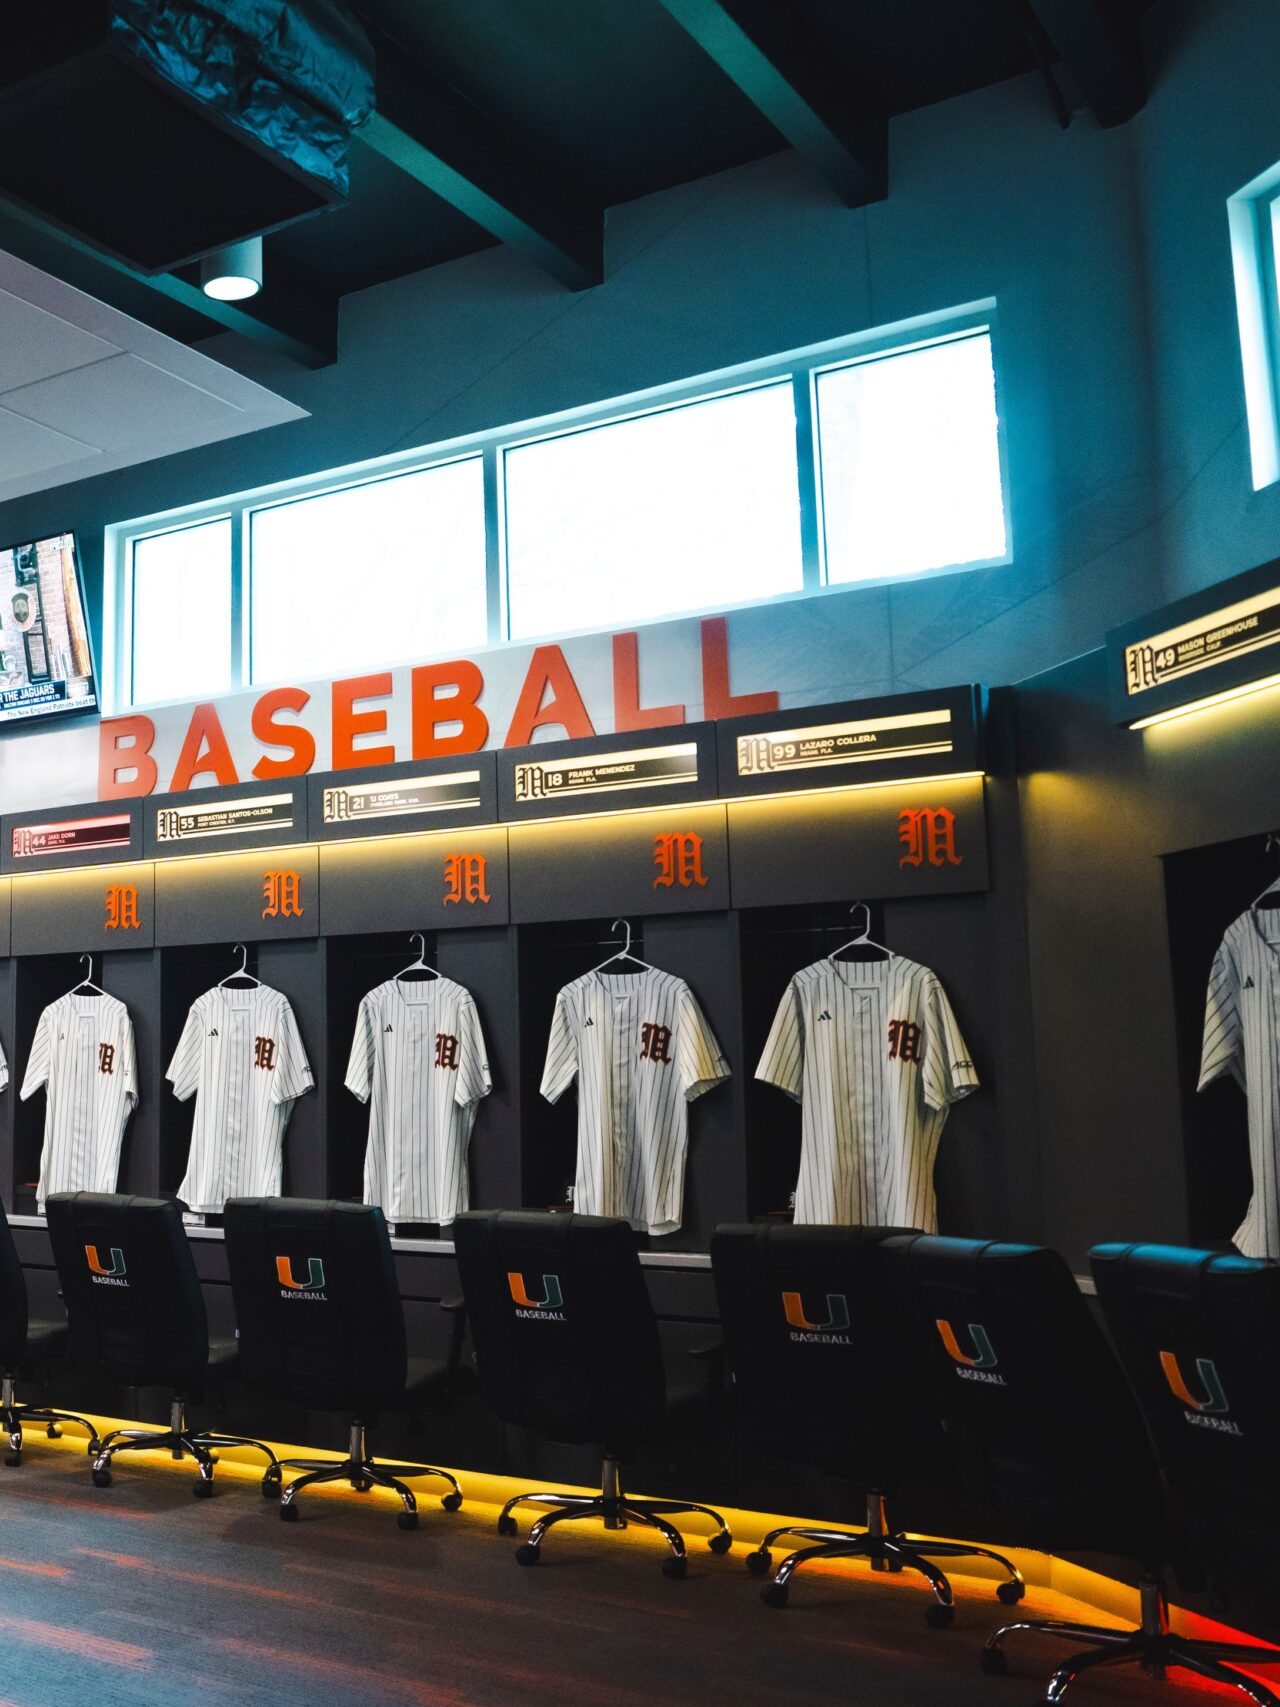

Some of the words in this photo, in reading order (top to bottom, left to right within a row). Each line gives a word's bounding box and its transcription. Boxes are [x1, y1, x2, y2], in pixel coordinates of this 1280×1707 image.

[1156, 649, 1175, 668] 49
[1177, 636, 1205, 654] MASON
[1206, 616, 1259, 643] GREENHOUSE
[4, 691, 19, 702] THE
[19, 684, 55, 700] JAGUARS
[97, 616, 780, 802] BASEBALL
[773, 744, 796, 759] 99
[800, 740, 834, 751] LAZARO
[837, 734, 877, 746] COLLERA
[548, 773, 562, 787] 18
[568, 769, 593, 779] FRANK
[596, 764, 635, 775] MENENDEZ
[353, 797, 364, 809] 21
[378, 793, 399, 801] COATS
[181, 817, 194, 829] 55
[197, 813, 227, 822] SEBASTIAN
[228, 808, 273, 818] SANTOS-OLSON
[32, 836, 46, 847] 44
[85, 1245, 126, 1276] U
[276, 1256, 325, 1289] U
[92, 1275, 130, 1287] BASEBALL
[508, 1272, 563, 1308] U
[281, 1289, 328, 1301] BASEBALL
[516, 1308, 567, 1321] BASEBALL
[782, 1292, 850, 1330] U
[790, 1331, 853, 1345] BASEBALL
[936, 1319, 998, 1367] U
[956, 1366, 1007, 1385] BASEBALL
[1160, 1351, 1229, 1412] U
[1184, 1410, 1243, 1436] BASEBALL
